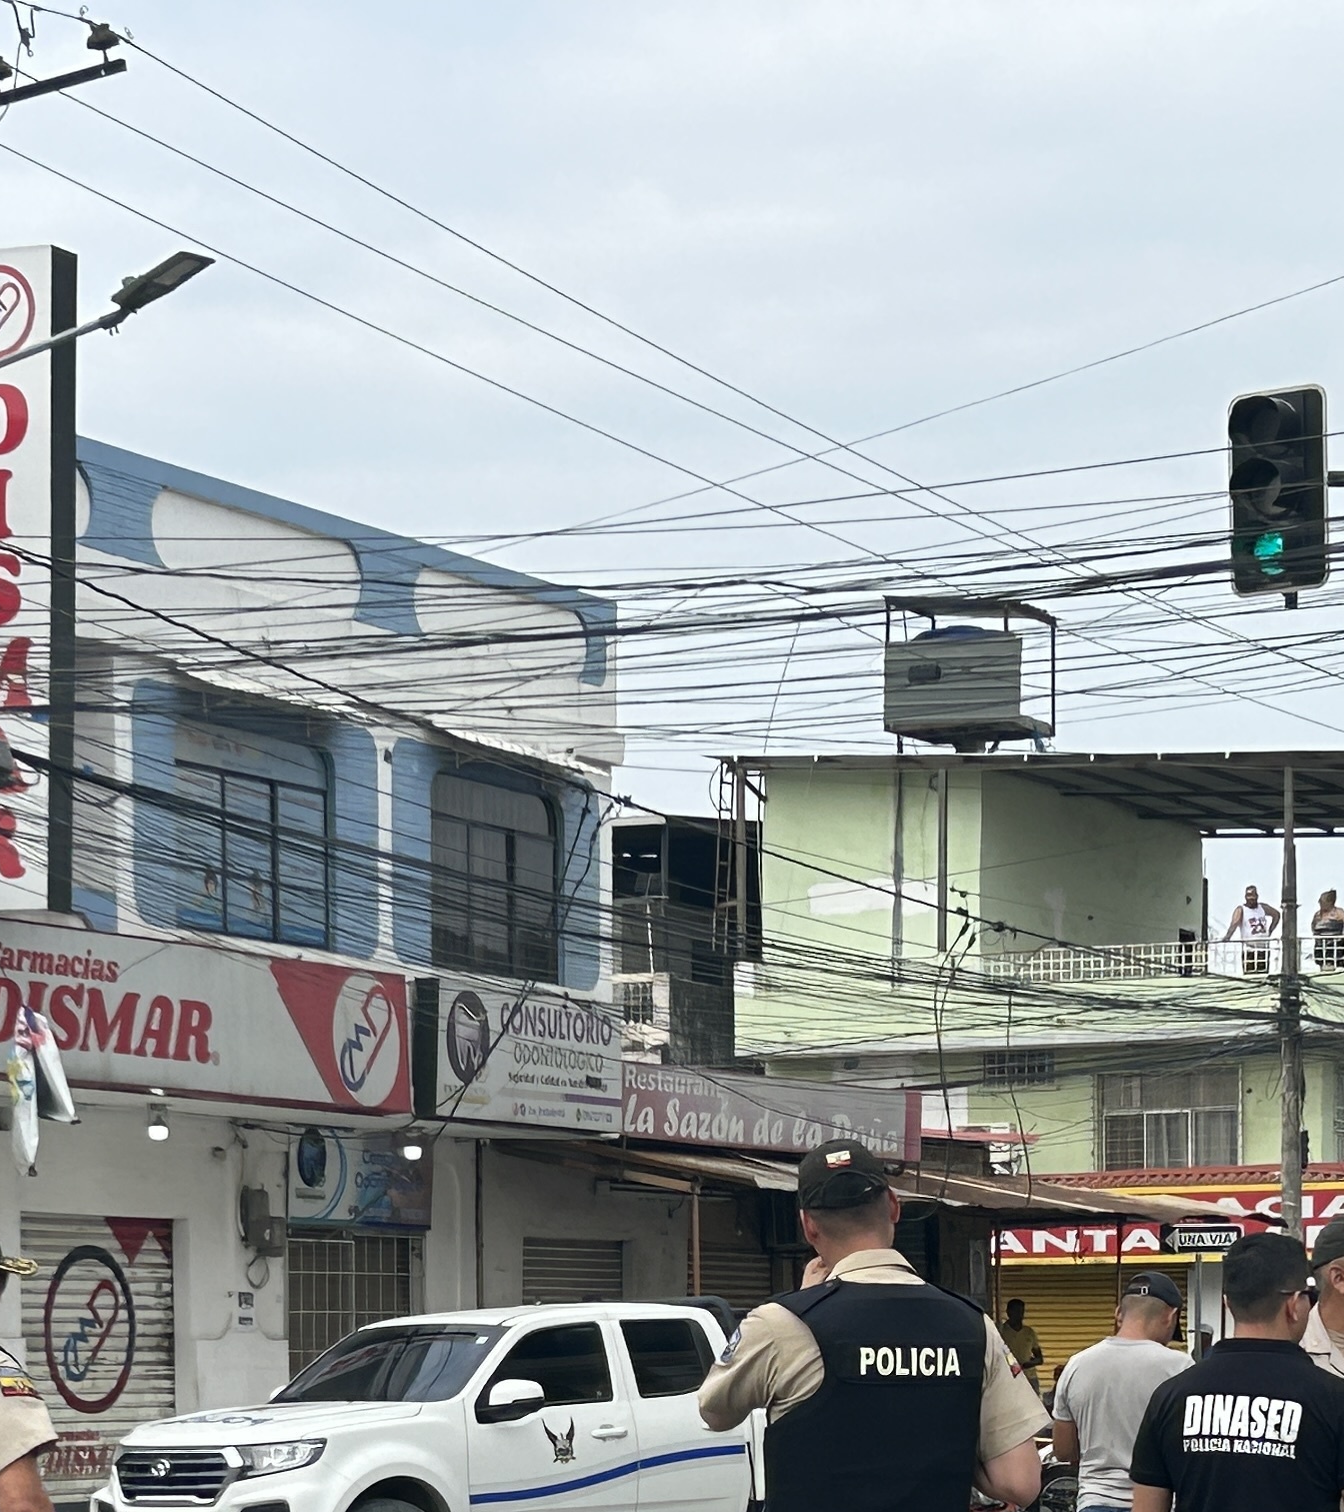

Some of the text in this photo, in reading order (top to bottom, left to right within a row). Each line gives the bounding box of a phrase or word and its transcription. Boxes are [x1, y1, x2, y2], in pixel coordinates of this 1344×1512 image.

[501, 1002, 613, 1046] CONSULTORIO
[624, 1094, 654, 1134] La
[753, 1110, 784, 1145] de
[792, 1110, 822, 1149] la
[995, 1228, 1162, 1253] ANTA
[1179, 1232, 1232, 1245] UNA VIA
[860, 1347, 961, 1376] POLICIA
[1183, 1394, 1303, 1443] DINASED
[1183, 1438, 1296, 1459] POLICIA NACIONAL
